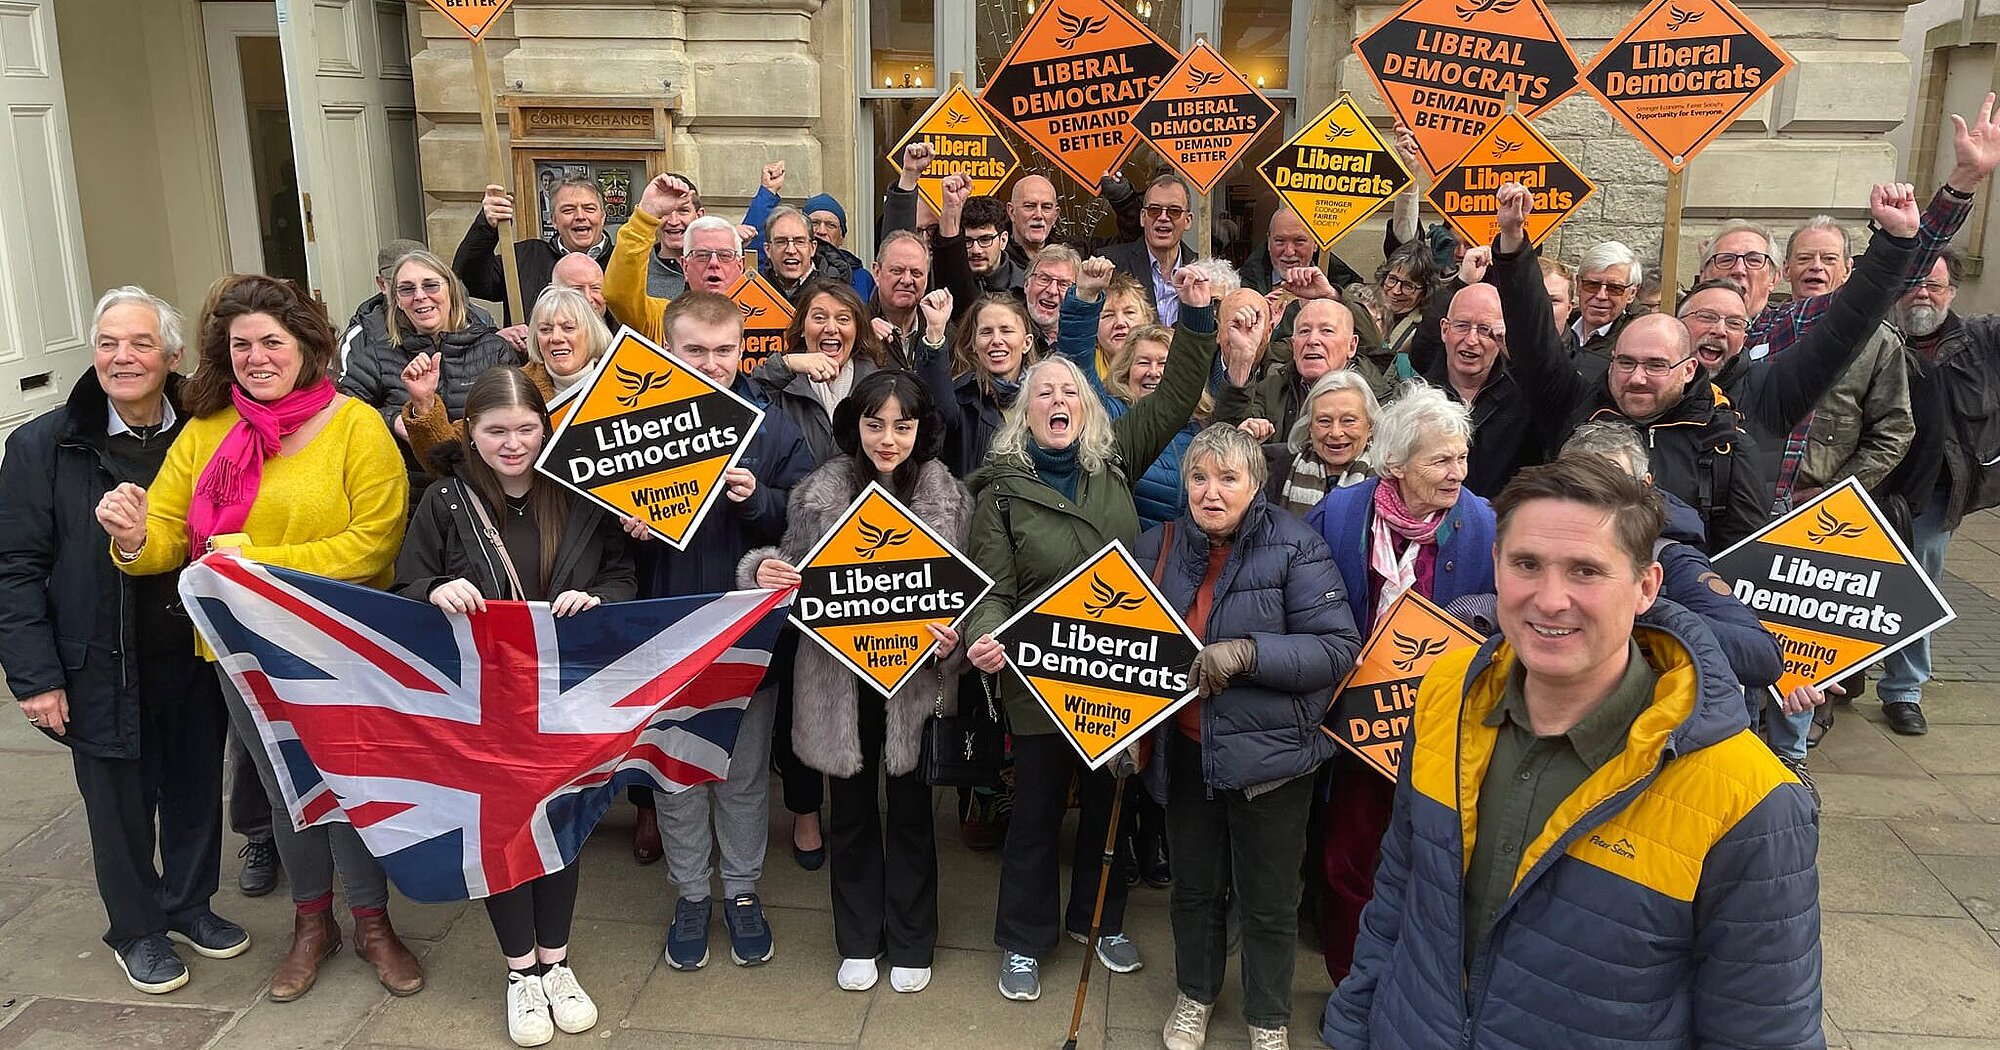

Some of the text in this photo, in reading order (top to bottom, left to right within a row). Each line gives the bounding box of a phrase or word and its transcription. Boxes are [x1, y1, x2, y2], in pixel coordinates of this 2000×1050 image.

[1416, 28, 1526, 67] LIBERAL
[1632, 38, 1731, 70] Liberal
[1033, 53, 1134, 87] LIBERAL
[1383, 52, 1550, 99] DEMOCRATS
[1606, 63, 1762, 97] Democrats
[1012, 75, 1161, 117] DEMOCRATS
[1167, 98, 1239, 117] LIBERAL
[1411, 89, 1501, 118] DEMAND
[530, 113, 650, 126] CORN EXCHANGE
[1050, 110, 1130, 135] DEMAND
[1150, 115, 1257, 137] DEMOCRATS
[1415, 110, 1487, 137] BETTER
[1636, 111, 1678, 120] Opportunity
[1059, 130, 1125, 153] BETTER
[1175, 137, 1232, 151] DEMAND
[921, 157, 1006, 177] emocrats
[1181, 151, 1228, 164] BETTER
[1296, 147, 1373, 173] Liberal
[1275, 166, 1393, 195] Democrats
[1315, 199, 1353, 208] STRONGER
[594, 401, 703, 452] Liberal
[568, 425, 739, 484] Democrats
[630, 479, 700, 508] Winning
[648, 496, 692, 522] Here!
[829, 563, 932, 596] Liberal
[1768, 554, 1882, 598] Liberal
[800, 588, 966, 622] Democrats
[1733, 578, 1902, 636] Democrats
[853, 633, 919, 652] Winning
[1050, 621, 1159, 662] Liberal
[867, 650, 908, 668] Here!
[1017, 641, 1188, 692] Democrats
[1784, 660, 1819, 680] ere!
[1064, 693, 1131, 725] Winning
[1073, 714, 1117, 739] Here!
[1589, 835, 1635, 860] Peter Storm
